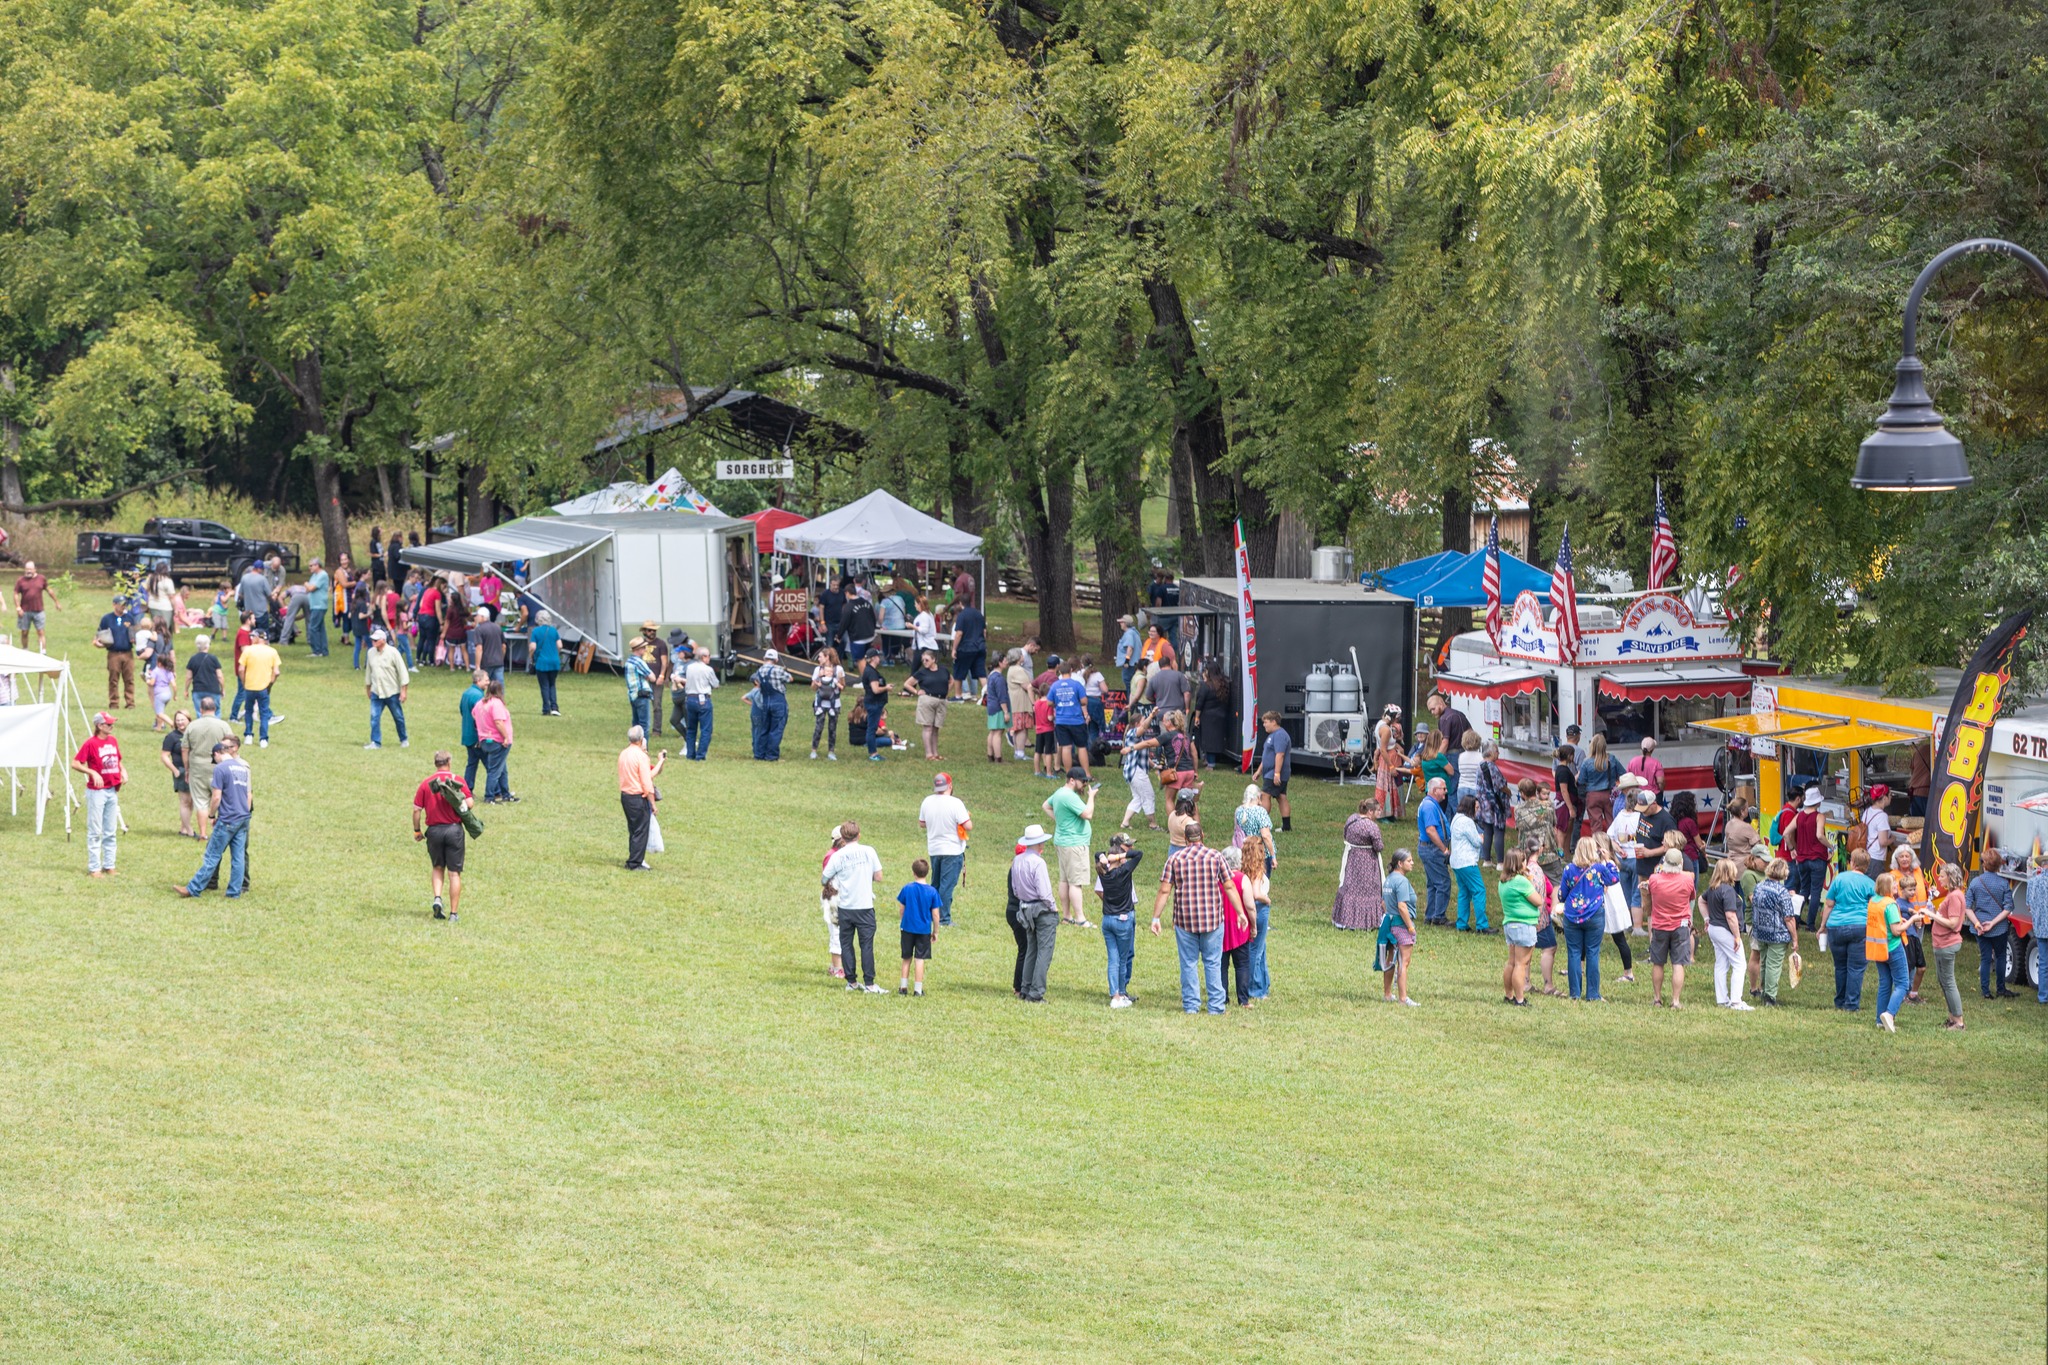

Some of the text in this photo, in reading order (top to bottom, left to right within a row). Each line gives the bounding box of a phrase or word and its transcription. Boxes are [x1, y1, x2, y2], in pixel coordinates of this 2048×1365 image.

[726, 464, 783, 475] SORGHUM
[775, 593, 806, 603] KIDS
[774, 604, 807, 613] ZONE
[1626, 598, 1690, 631] MTN-SNO
[1579, 636, 1600, 646] Sweet
[1630, 638, 1686, 653] SHAVED ICE
[1585, 648, 1597, 656] Tea
[2013, 732, 2048, 759] 62 TR
[1938, 672, 2002, 849] BBQ
[1987, 784, 2003, 794] VETERAN
[1988, 794, 2002, 804] OWNED
[1986, 806, 2004, 817] OPERATED
